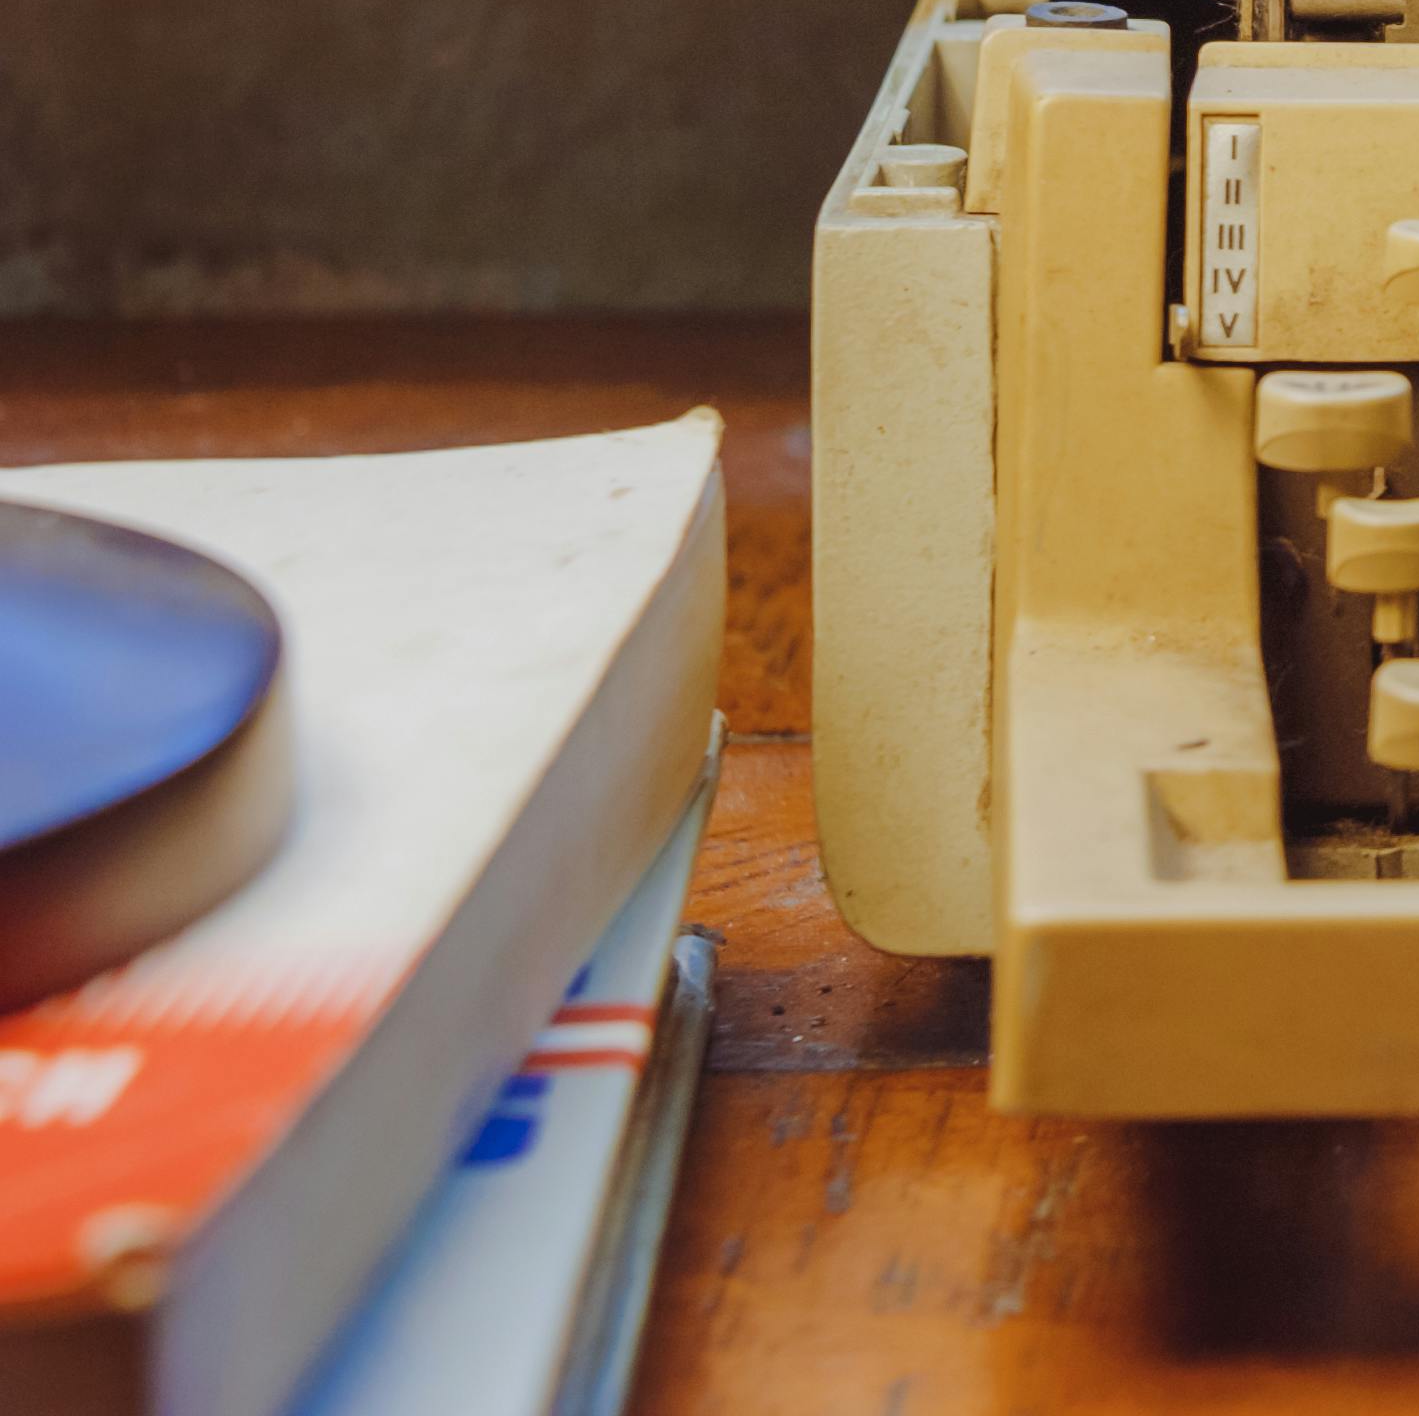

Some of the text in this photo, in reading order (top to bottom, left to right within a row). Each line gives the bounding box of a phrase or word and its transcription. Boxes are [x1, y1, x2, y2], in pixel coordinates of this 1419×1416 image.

[1225, 179, 1241, 205] II
[1219, 225, 1244, 250] III
[1213, 269, 1245, 294] IV
[1219, 313, 1239, 338] V
